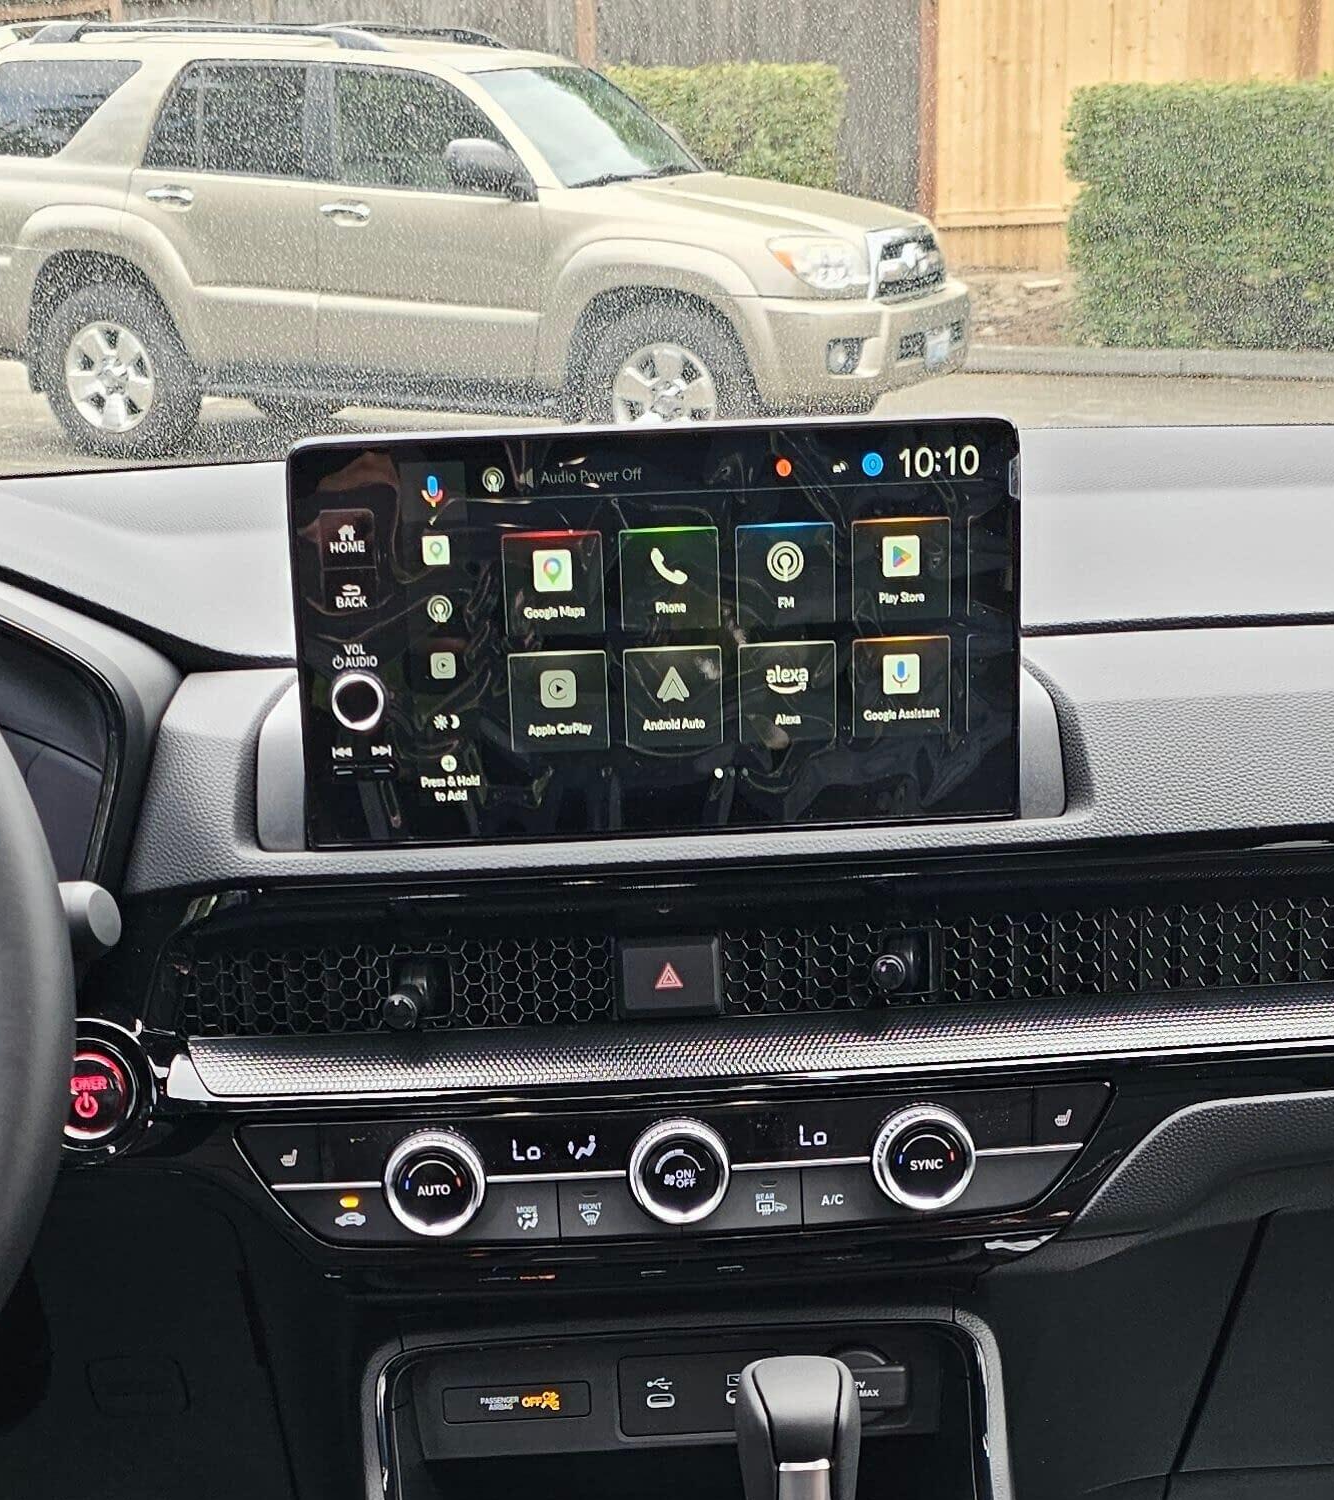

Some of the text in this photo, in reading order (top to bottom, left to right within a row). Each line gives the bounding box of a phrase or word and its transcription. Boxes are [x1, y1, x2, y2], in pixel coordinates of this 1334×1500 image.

[898, 444, 980, 478] 10:10
[541, 467, 643, 484] Audio Power Off
[329, 540, 366, 554] HOME
[335, 594, 368, 609] BACK
[777, 596, 795, 609] FM
[878, 591, 925, 605] Play Store
[523, 605, 586, 622] Google Maps
[655, 601, 687, 614] Phone
[343, 644, 366, 656] VOL
[345, 656, 378, 668] AUDIO
[766, 664, 809, 684] alexa
[775, 713, 802, 726] Alexa
[863, 707, 941, 722] Google Assistant
[528, 722, 593, 738] Apple CarPlay
[643, 718, 706, 731] Android Auto
[70, 1075, 107, 1091] OWER
[909, 1158, 944, 1171] SYNC
[675, 1170, 696, 1180] ON/
[675, 1178, 697, 1189] OFF
[417, 1184, 451, 1197] AUTO
[821, 1194, 844, 1207] A/C
[578, 1203, 602, 1212] FRONT
[859, 1388, 880, 1397] MAX
[479, 1395, 520, 1405] PASSENGER
[521, 1396, 543, 1408] OFF
